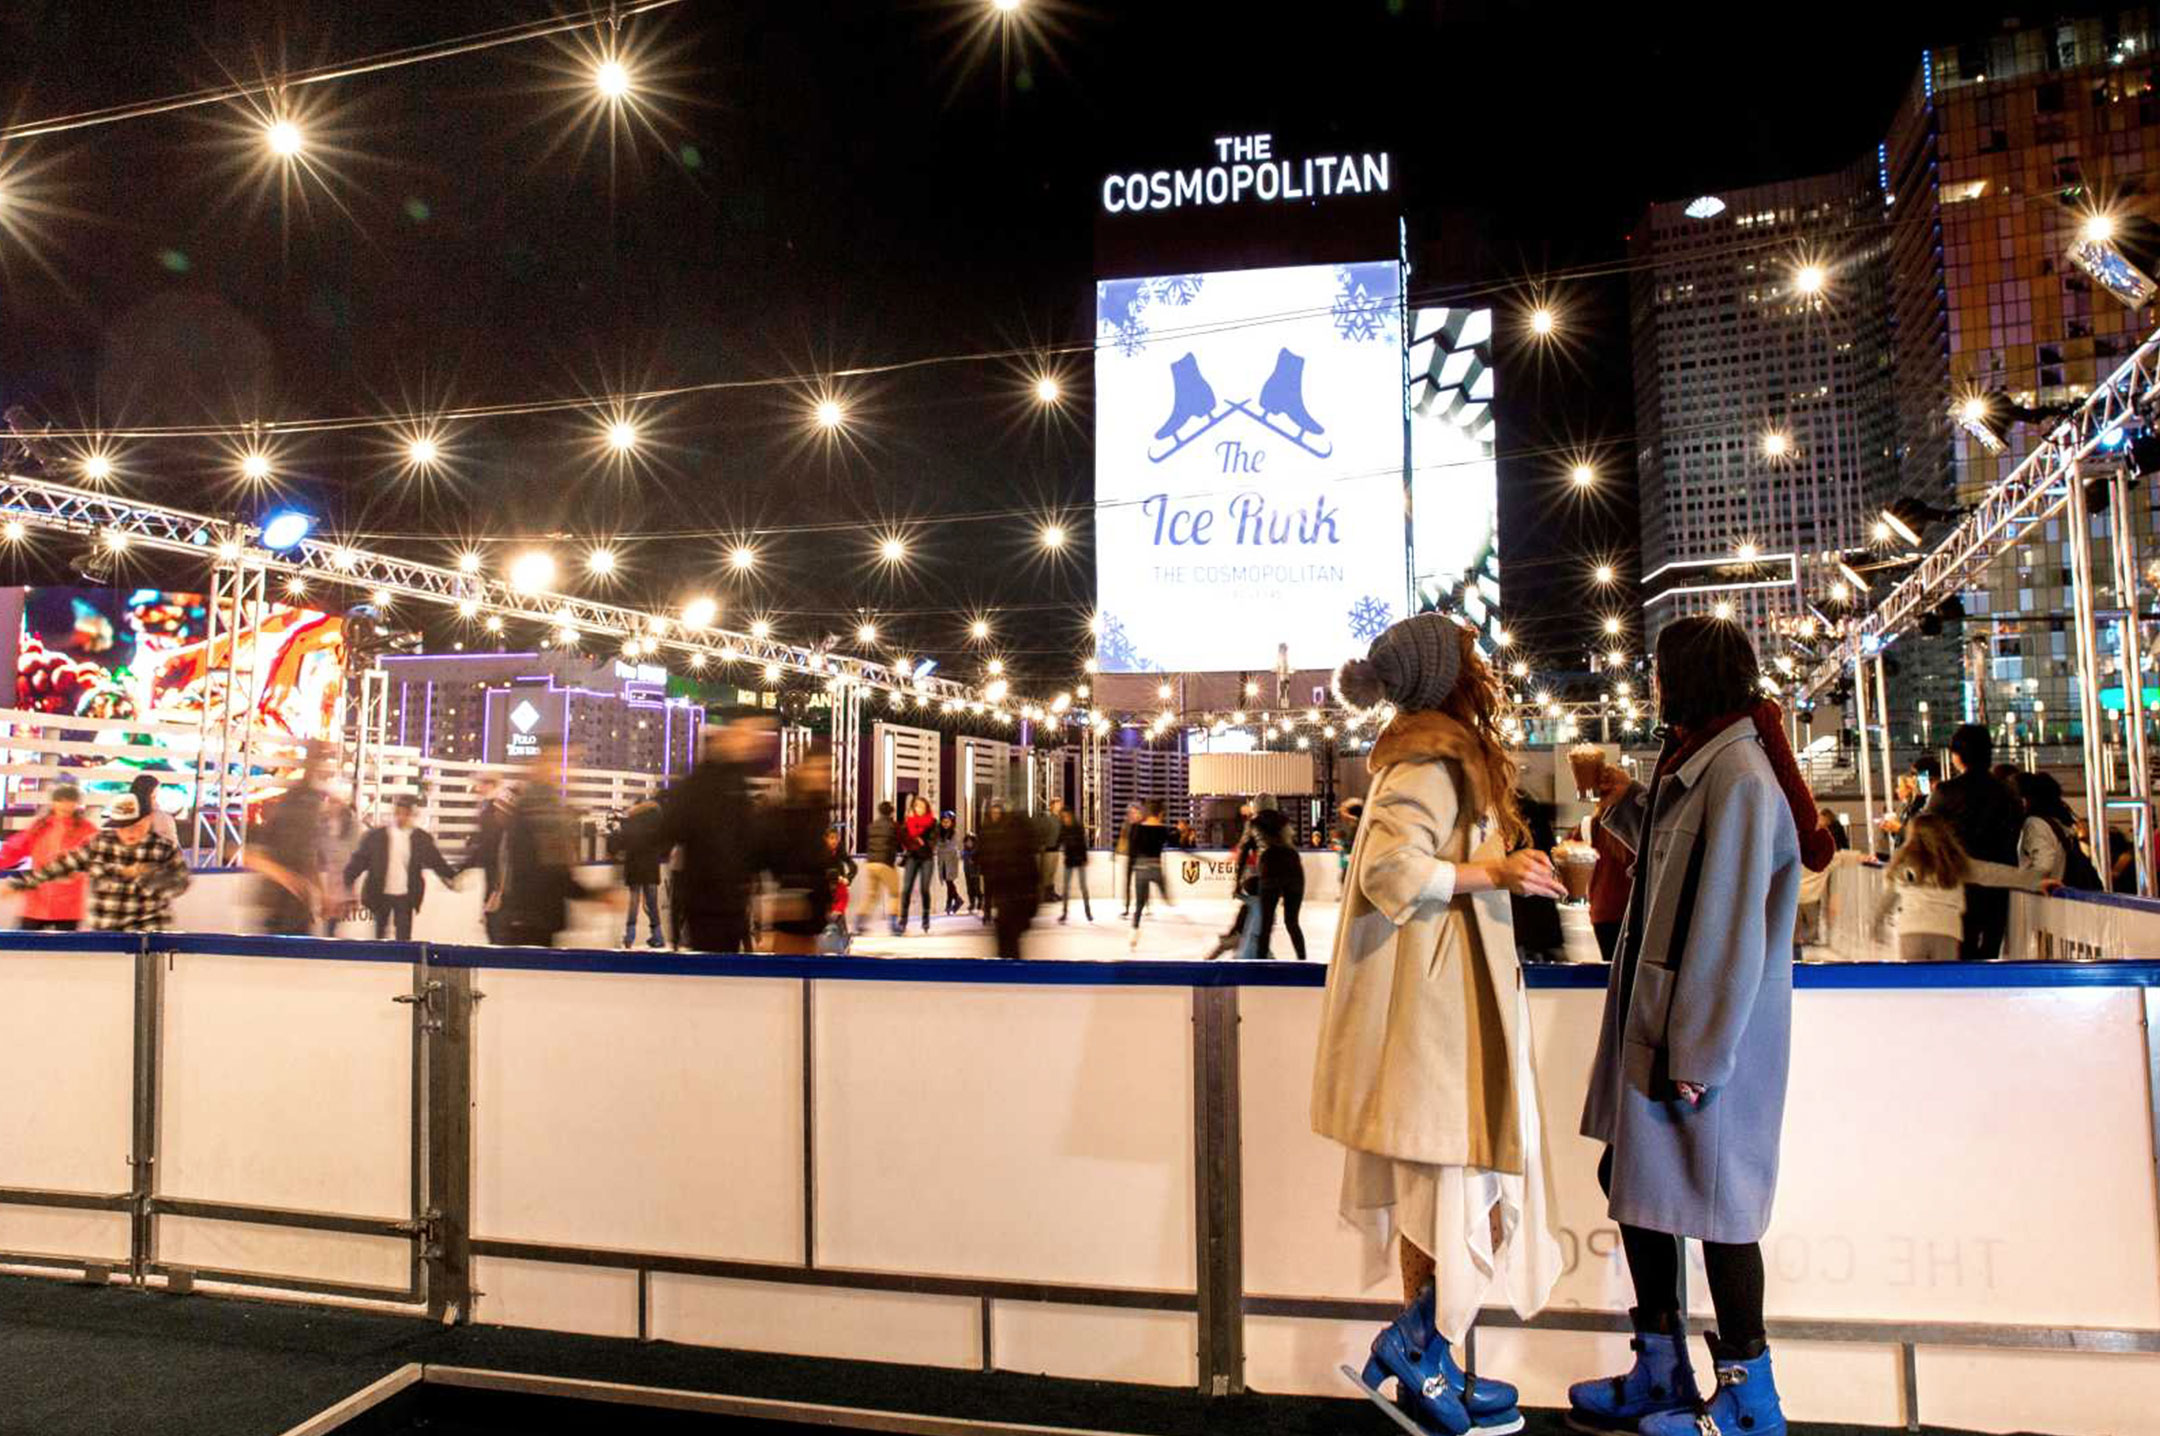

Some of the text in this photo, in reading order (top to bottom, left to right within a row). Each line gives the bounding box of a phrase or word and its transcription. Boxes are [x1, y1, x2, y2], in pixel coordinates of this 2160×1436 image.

[1215, 134, 1271, 163] THE
[1103, 152, 1388, 213] COSMOPOLITAN
[1215, 441, 1266, 474] The
[1143, 493, 1214, 546] Ice
[1153, 564, 1344, 584] THE COSMOPOLITAN
[1208, 861, 1241, 875] VEG
